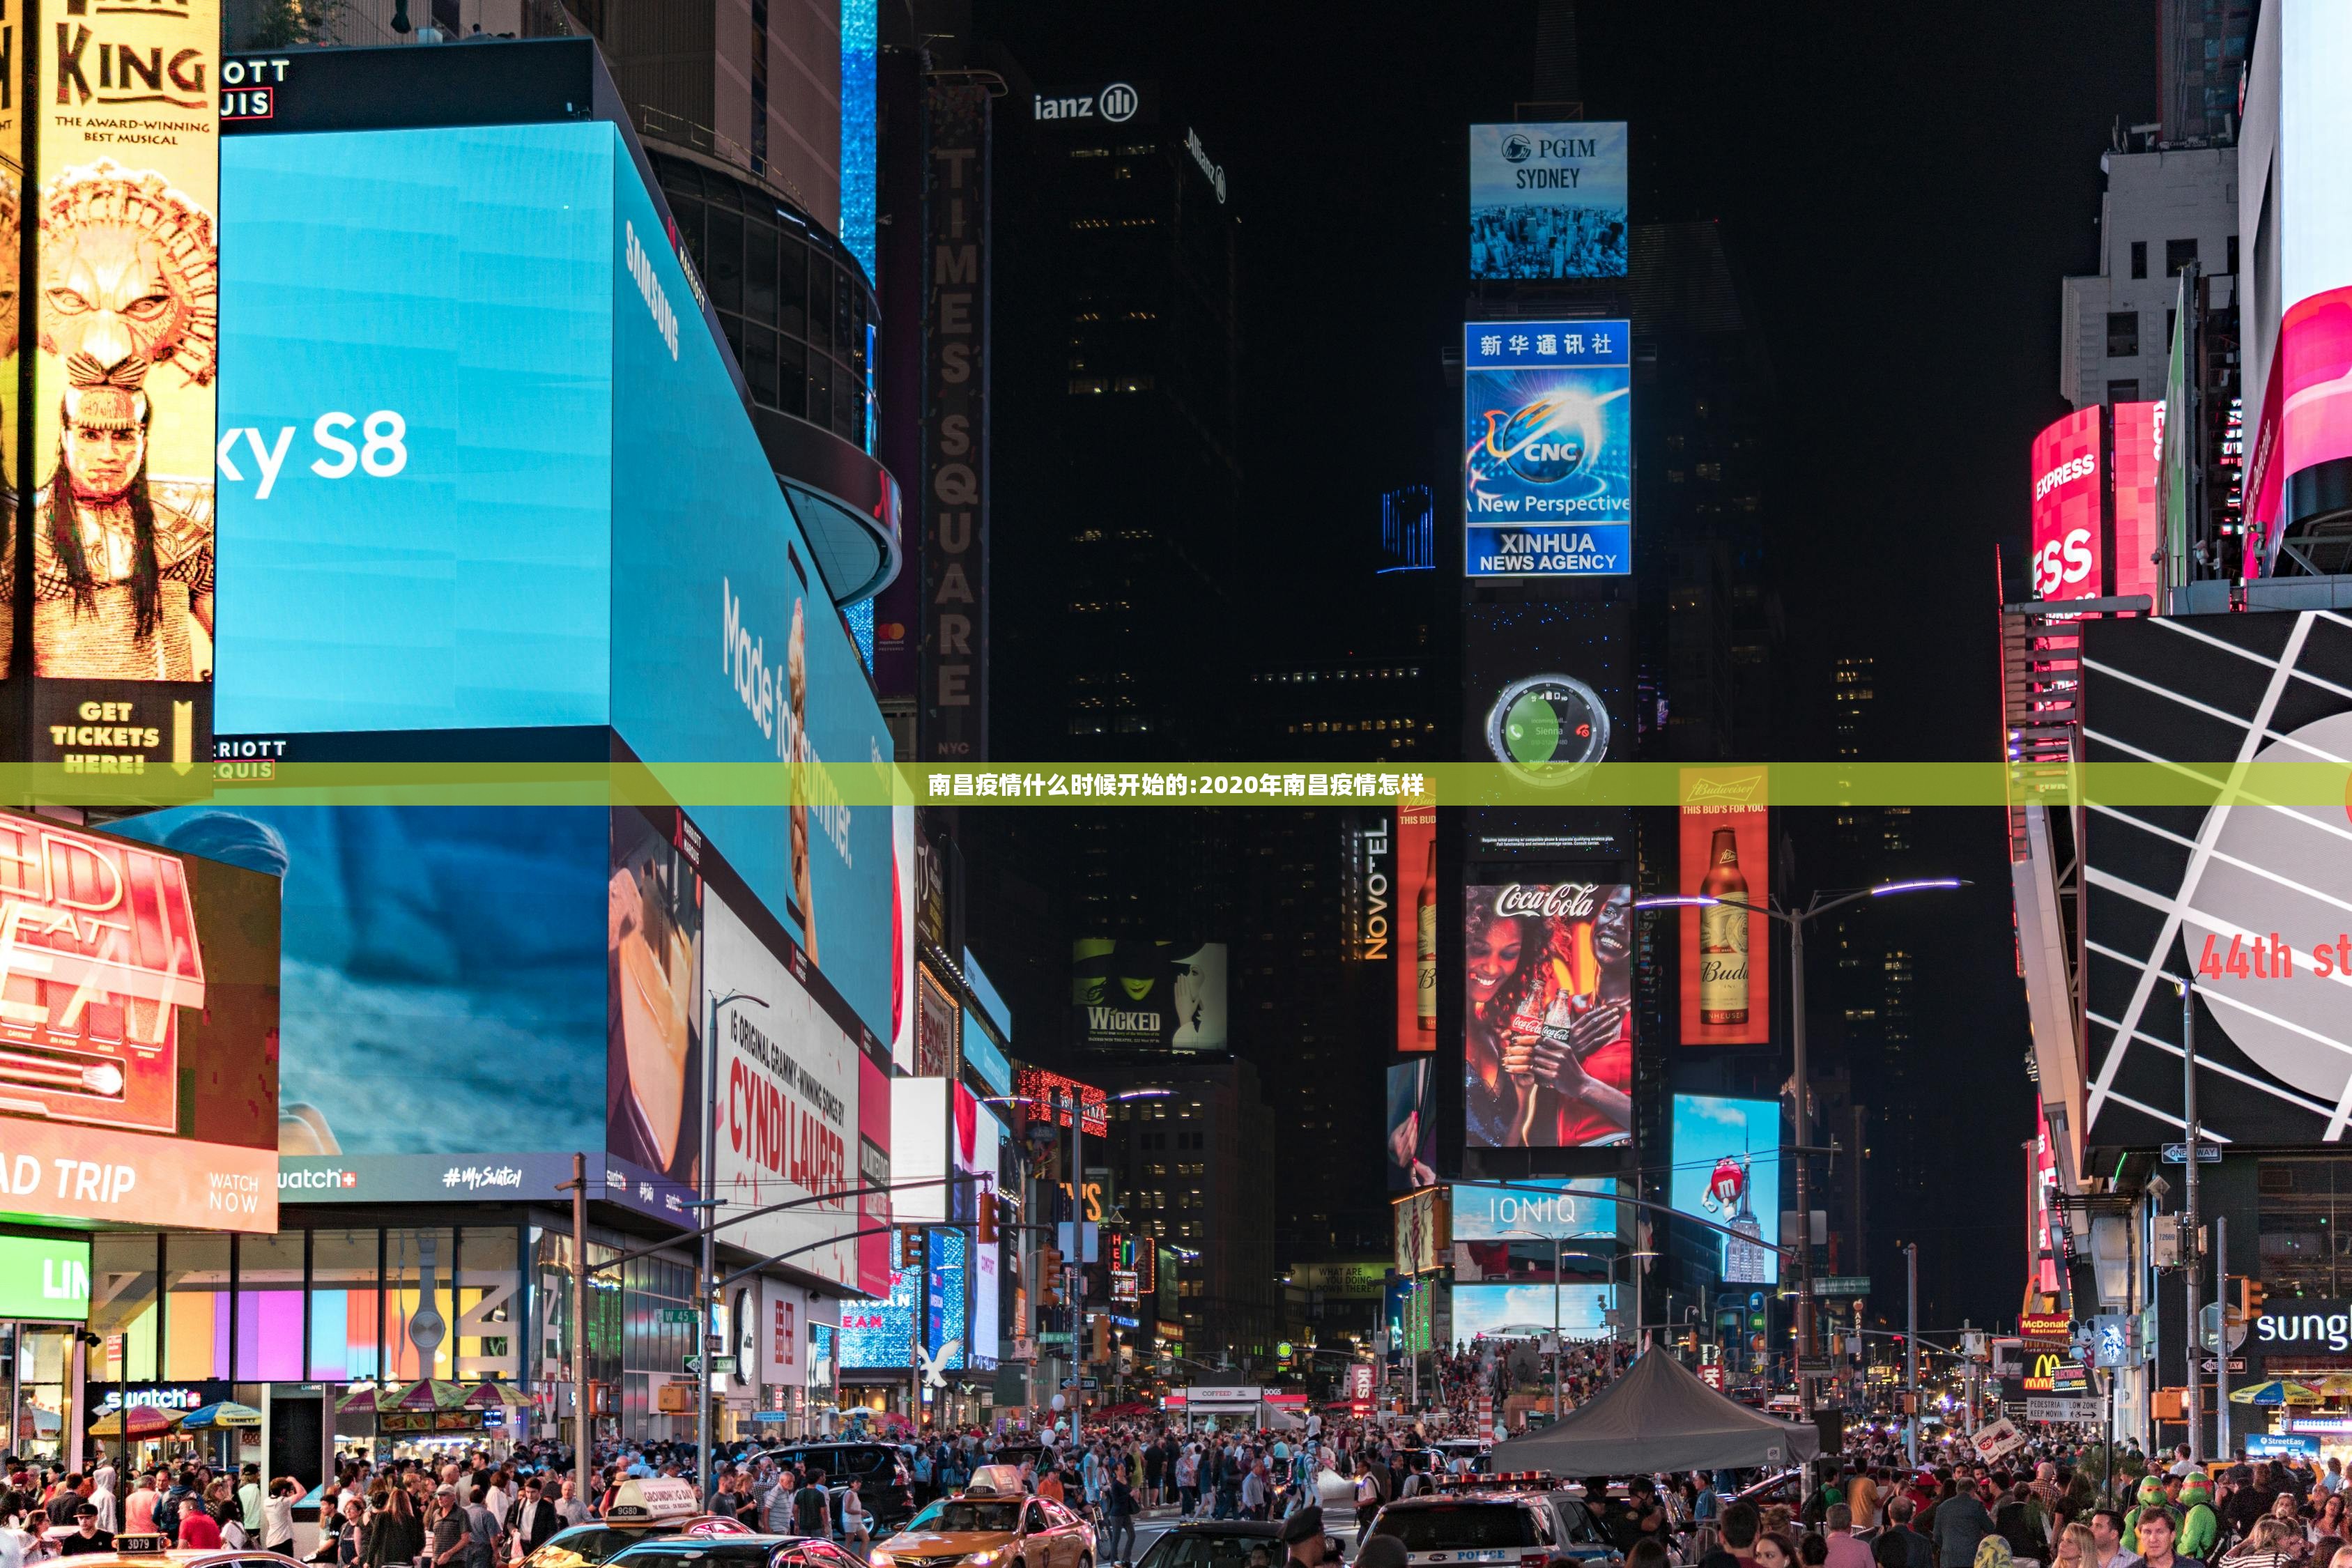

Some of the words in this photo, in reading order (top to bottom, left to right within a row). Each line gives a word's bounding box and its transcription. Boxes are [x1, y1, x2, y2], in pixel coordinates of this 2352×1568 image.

[56, 22, 208, 107] KING
[1035, 95, 1093, 120] ianz
[55, 116, 82, 127] THE
[86, 118, 210, 133] AWARD-WINNING
[84, 133, 112, 143] BEST
[117, 134, 178, 145] MUSICAL
[1539, 139, 1597, 158] PGIM
[1188, 126, 1215, 185] Allianz
[1516, 168, 1580, 190] SYDNEY
[935, 148, 978, 385] TIMES
[679, 246, 705, 313] MARRIOTT
[626, 220, 679, 362] SAMSUNG
[1481, 334, 1612, 355] 新华通讯社
[310, 409, 408, 479] S8
[1524, 443, 1578, 462] CNC
[2036, 454, 2095, 502] EXPRESS
[1478, 495, 1520, 513] New
[1525, 495, 1630, 516] Perspective
[1501, 534, 1596, 553] XINHUA
[934, 414, 978, 707] SQUARE
[1480, 556, 1535, 571] NEWS
[1539, 555, 1617, 570] AGENCY
[79, 702, 133, 722] GET
[723, 576, 773, 741] Made
[799, 731, 852, 870] summer.
[1535, 726, 1563, 735] Sienna
[50, 725, 160, 748] TICKETS
[213, 741, 287, 758] RIOTT
[938, 742, 969, 755] NYC
[64, 754, 144, 775] HERE!
[213, 762, 272, 780] QUIS
[1694, 783, 1754, 796] Budweiser
[1682, 805, 1701, 815] THIS
[1702, 805, 1728, 814] BUD'S
[1730, 804, 1746, 813] FOR
[1747, 803, 1766, 813] YOU.
[1400, 816, 1418, 825] THIS
[1365, 818, 1388, 960] NOVOTEL
[1496, 882, 1599, 917] Coca-Cola
[2198, 932, 2293, 980] 44th
[730, 1007, 738, 1042] 16
[739, 1014, 770, 1069] ORIGINAL
[823, 1086, 838, 1122] SONGS
[838, 1100, 845, 1128] BY
[730, 1056, 787, 1178] CYNDI
[790, 1099, 847, 1211] LAUPER
[54, 1158, 137, 1204] TRIP
[209, 1171, 259, 1193] WATCH
[210, 1191, 259, 1214] NOW
[1490, 1197, 1576, 1224] IONIQ
[1319, 1267, 1344, 1277] WHAT
[1346, 1268, 1362, 1276] ARE
[1325, 1276, 1343, 1285] YOU
[1345, 1276, 1372, 1285] DOING
[1316, 1284, 1342, 1294] DOWN
[1345, 1284, 1378, 1293] THERE?
[1828, 1279, 1838, 1292] W
[1843, 1279, 1856, 1292] 45
[664, 1311, 675, 1322] W
[677, 1311, 690, 1322] 45
[2257, 1305, 2352, 1351] sung
[1054, 1334, 1064, 1342] 45
[713, 1360, 729, 1368] WAY
[1357, 1367, 1371, 1399] tkts
[2055, 1369, 2086, 1379] ELECTRONIC
[2030, 1409, 2045, 1417] KEEP
[2082, 1401, 2098, 1409] ZONE
[146, 1421, 165, 1430] BEEF
[2268, 1437, 2305, 1447] StreetEasy
[644, 1490, 682, 1502] GROUNDHOG
[682, 1489, 693, 1500] DAY
[617, 1507, 638, 1515] 9G80
[128, 1538, 150, 1550] 3D79
[1456, 1548, 1505, 1560] POLICE
